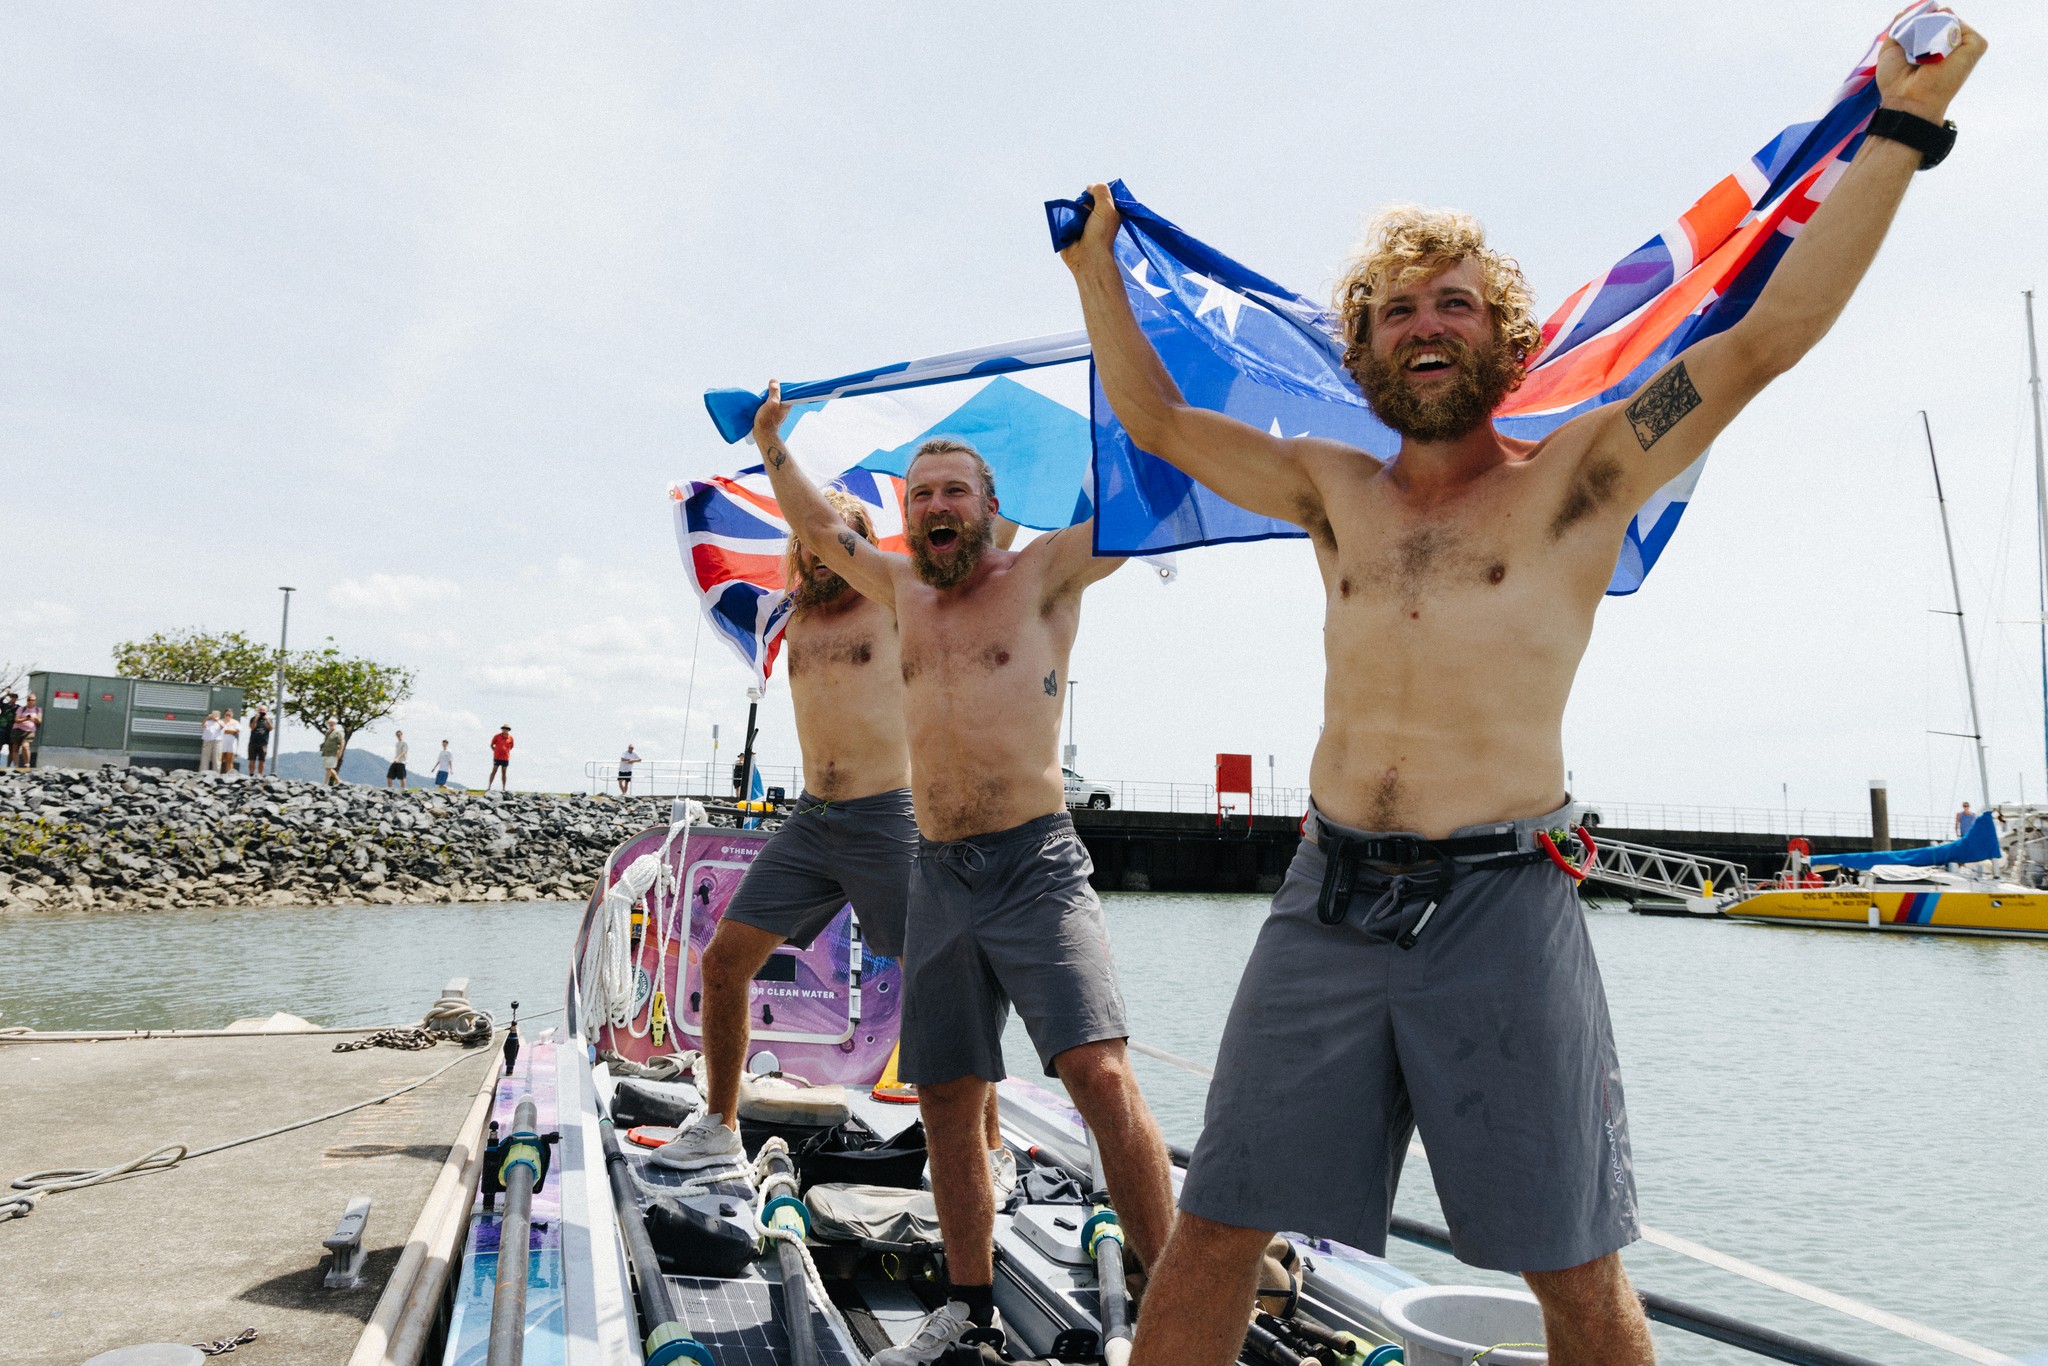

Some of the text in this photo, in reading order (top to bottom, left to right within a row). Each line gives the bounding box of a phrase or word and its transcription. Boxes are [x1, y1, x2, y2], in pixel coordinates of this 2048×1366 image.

[1803, 892, 1817, 900] CYC
[1818, 892, 1833, 900] SAIL
[751, 987, 835, 999] OR CLEAN WATER
[1605, 1118, 1624, 1184] ATACAMA
